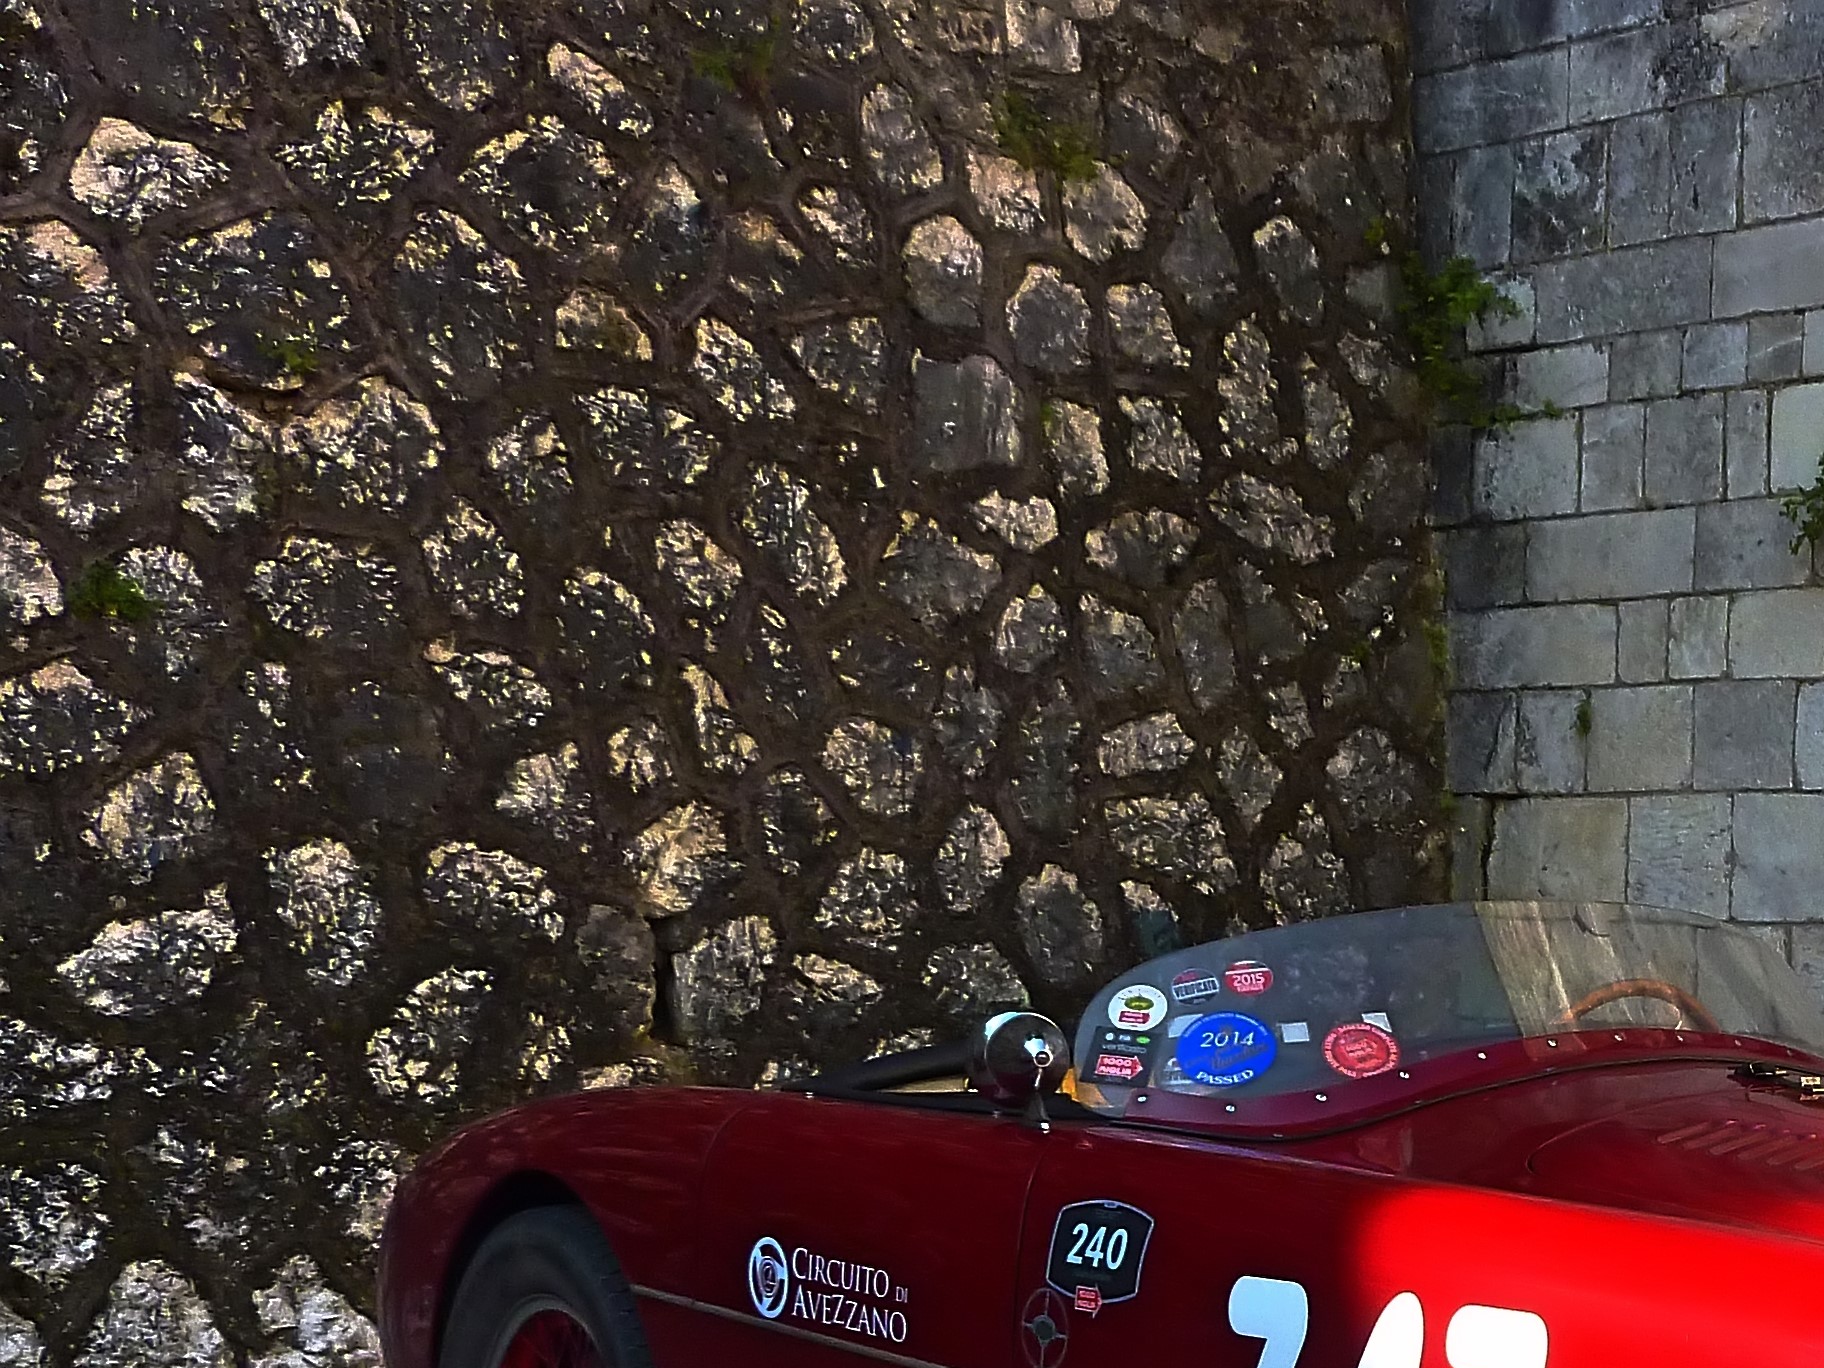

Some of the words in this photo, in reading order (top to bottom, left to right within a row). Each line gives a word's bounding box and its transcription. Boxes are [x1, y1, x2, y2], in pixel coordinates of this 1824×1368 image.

[1232, 972, 1265, 987] 2015
[1200, 1031, 1255, 1048] 2014
[1196, 1069, 1255, 1085] PASSED
[1066, 1222, 1129, 1271] 240
[792, 1247, 889, 1298] CIRCUITO
[791, 1284, 907, 1342] AVEZZANO
